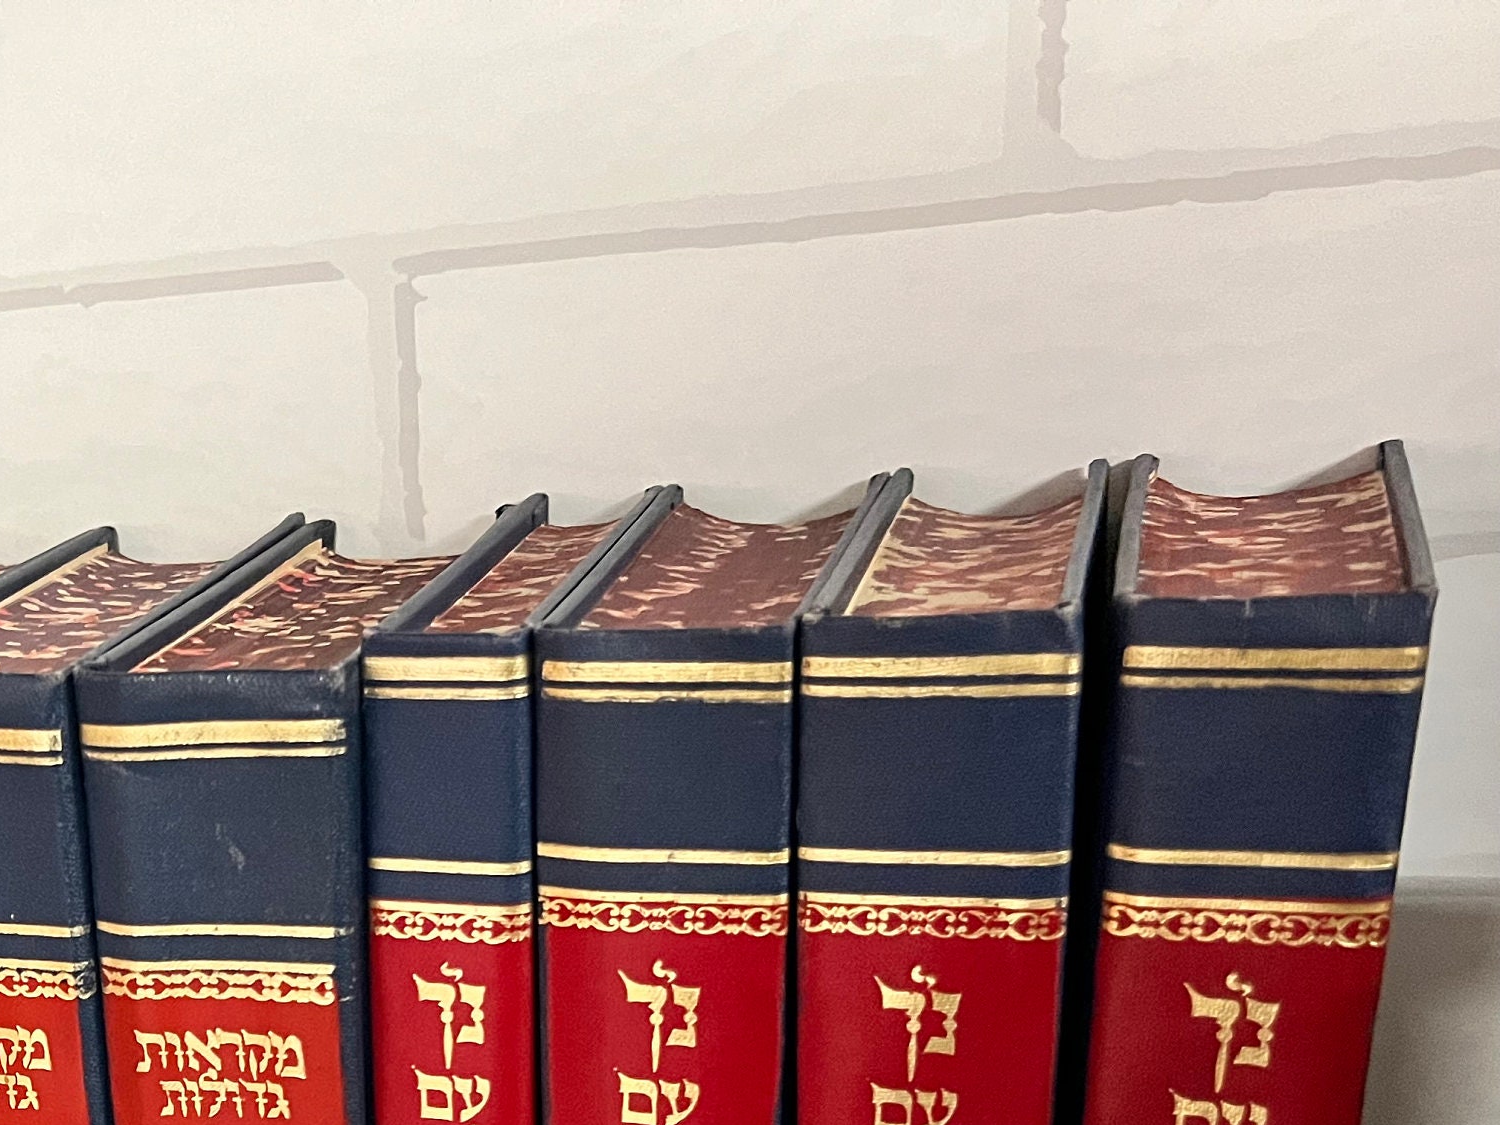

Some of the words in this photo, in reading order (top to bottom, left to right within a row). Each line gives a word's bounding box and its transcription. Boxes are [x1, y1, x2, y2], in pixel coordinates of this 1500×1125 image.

[133, 1026, 306, 1081] מקראות
[159, 1069, 291, 1120] גדולות
[414, 1067, 490, 1122] עם
